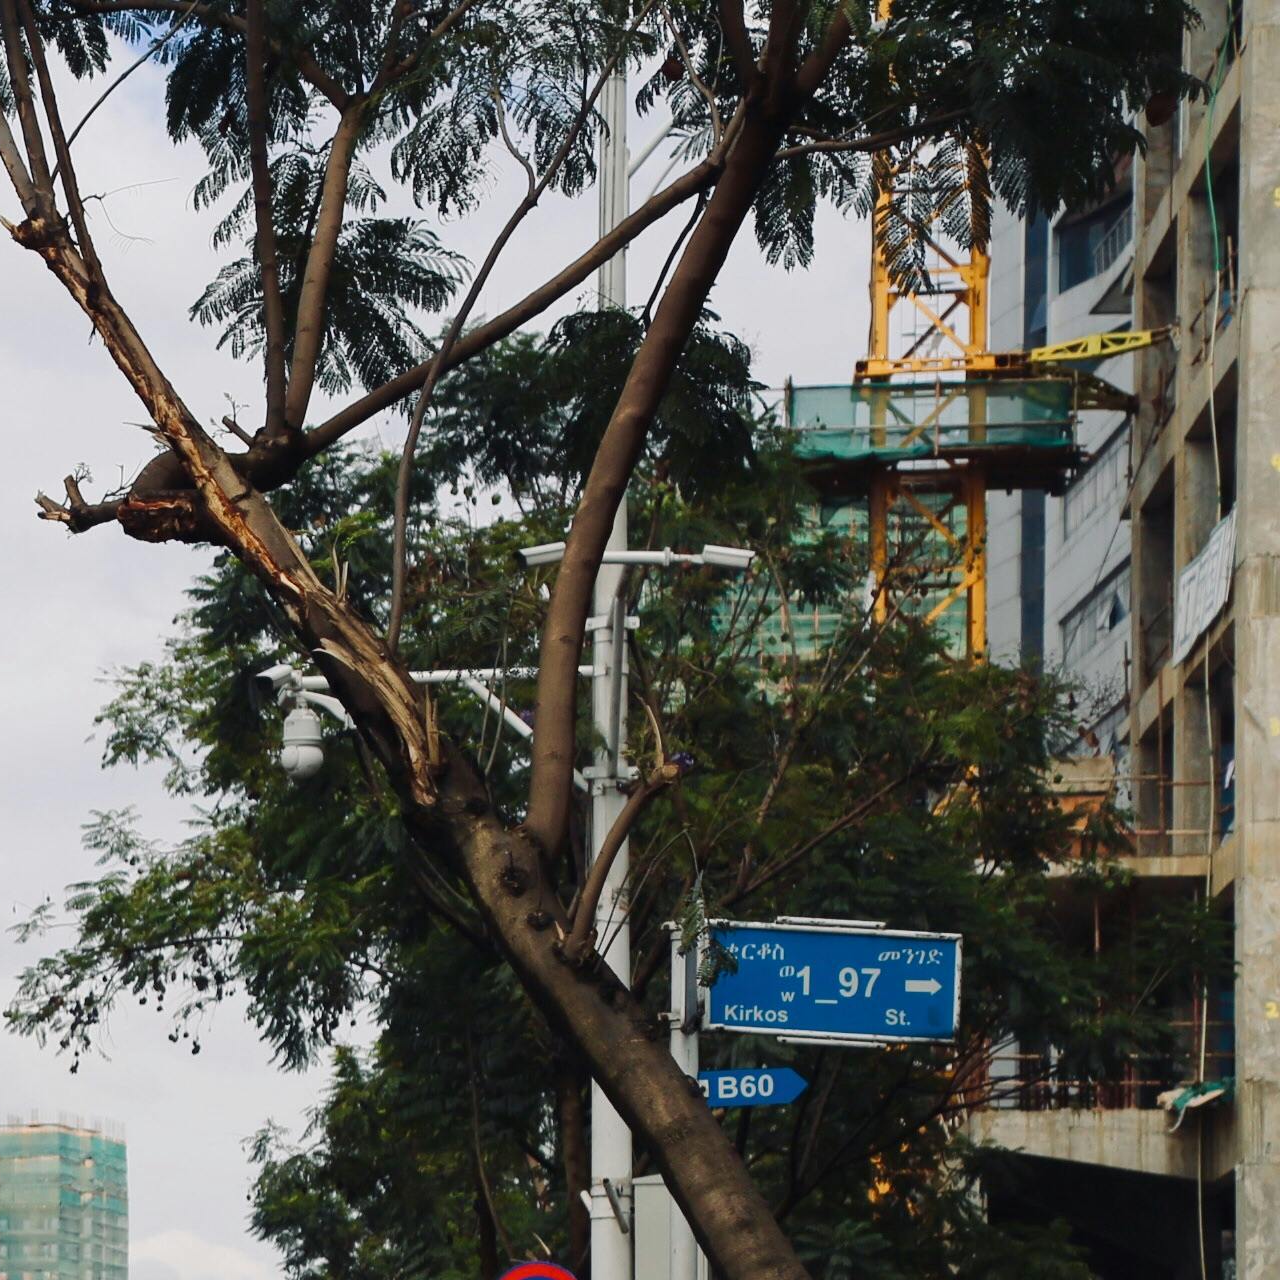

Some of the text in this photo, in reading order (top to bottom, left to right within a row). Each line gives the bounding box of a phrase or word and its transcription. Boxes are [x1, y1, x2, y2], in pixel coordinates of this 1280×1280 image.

[878, 948, 943, 965] መንገድ
[724, 1004, 911, 1026] Kirkos St.
[718, 1074, 774, 1099] B60
